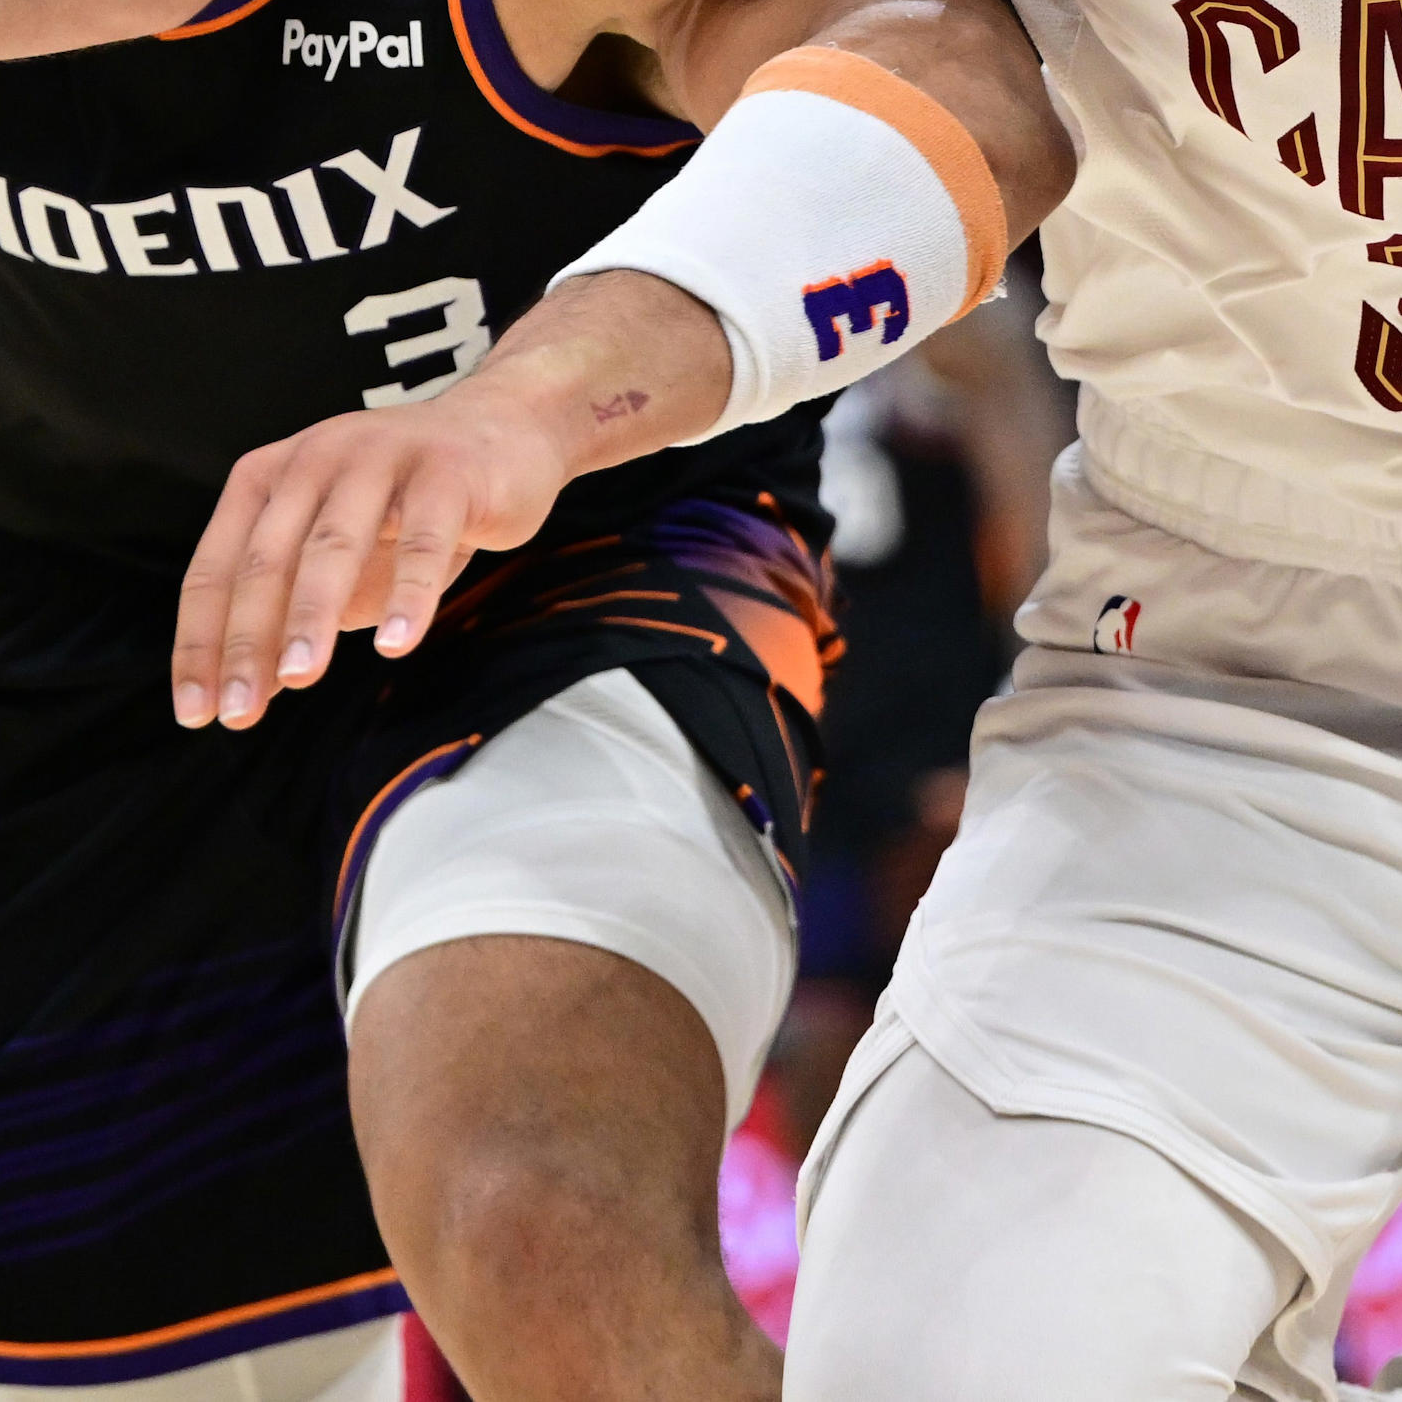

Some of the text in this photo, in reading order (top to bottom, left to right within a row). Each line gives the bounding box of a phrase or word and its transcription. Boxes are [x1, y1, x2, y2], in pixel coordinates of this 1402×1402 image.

[283, 19, 424, 82] PayPal
[344, 276, 494, 410] 3
[801, 259, 911, 362] 3
